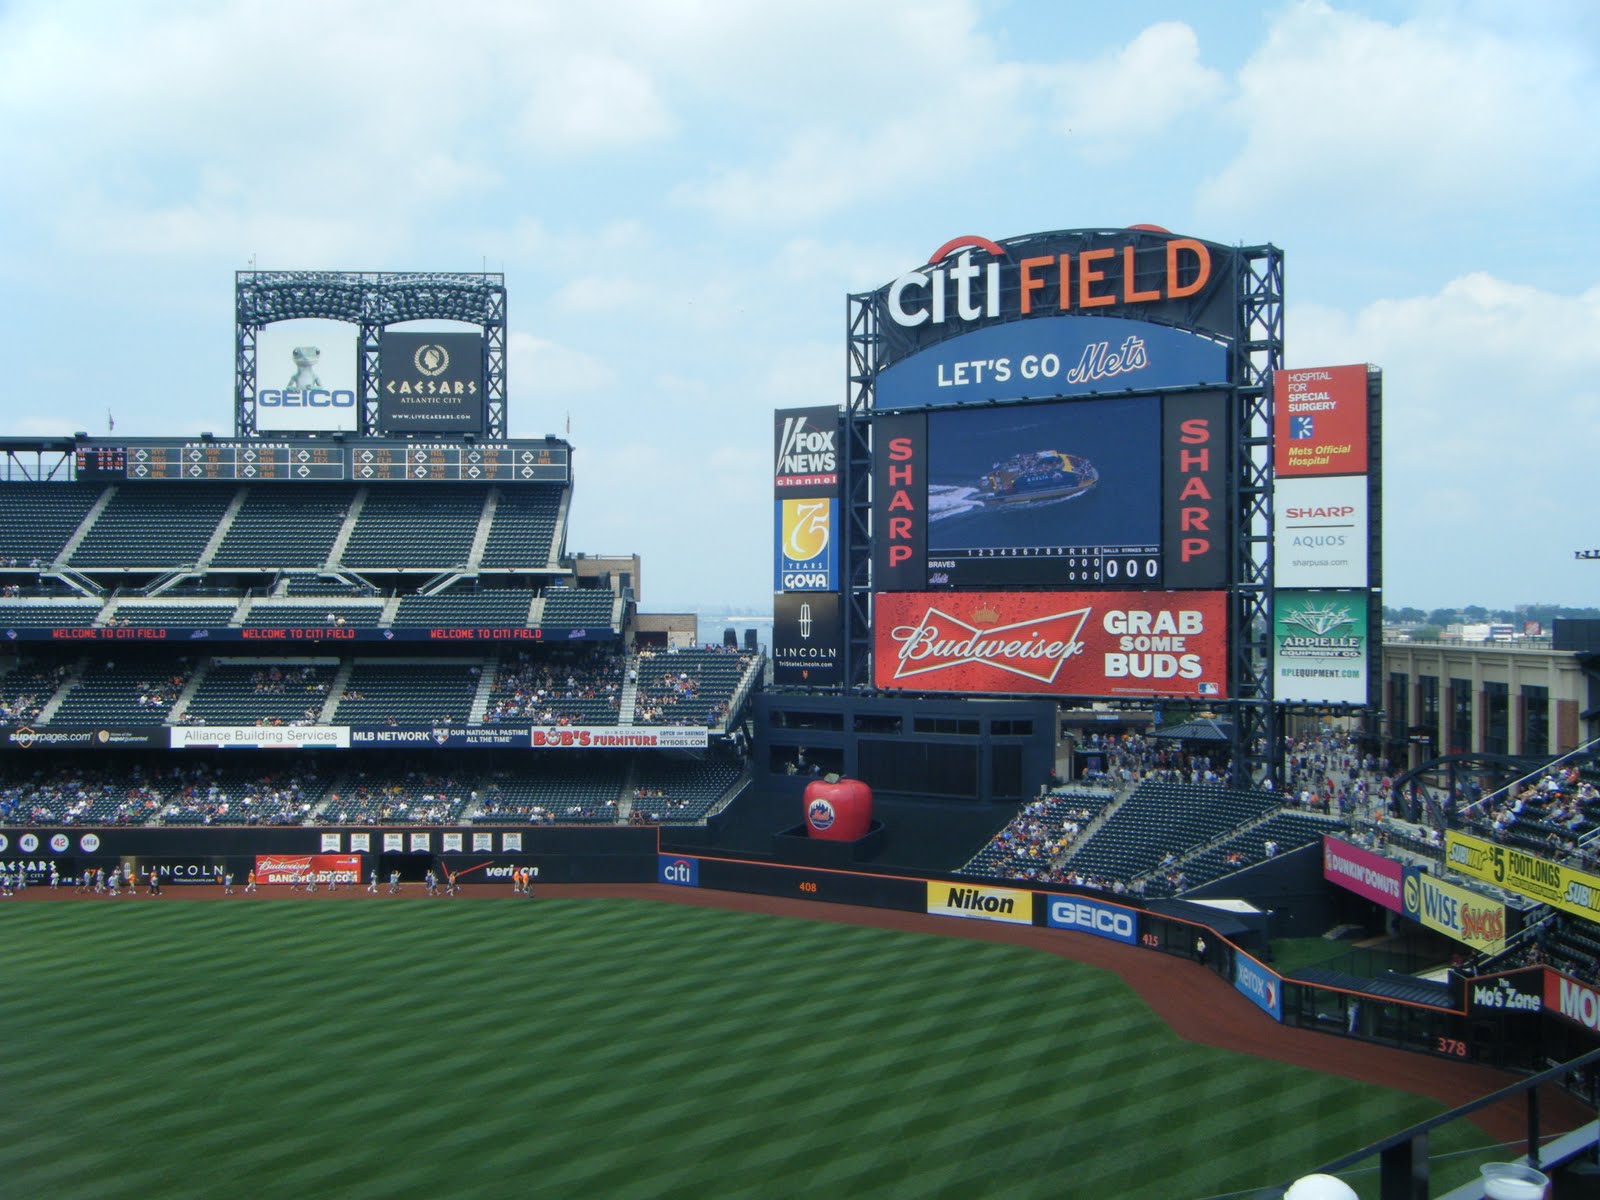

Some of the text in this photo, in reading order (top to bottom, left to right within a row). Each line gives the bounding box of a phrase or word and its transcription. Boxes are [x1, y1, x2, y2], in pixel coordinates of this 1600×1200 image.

[888, 239, 1212, 327] citi FIELD
[938, 336, 1148, 387] LET'S GO Mets
[1288, 371, 1332, 382] HOSPITAL
[386, 380, 477, 394] CAESARS
[1288, 383, 1307, 392] FOR
[259, 390, 354, 408] GEICO
[1288, 392, 1330, 402] SPECIAL
[1288, 401, 1336, 412] SURGERY
[796, 431, 835, 455] FOX
[1288, 444, 1351, 456] Mets Official
[785, 453, 836, 474] NEWS
[1288, 456, 1329, 467] Hospital
[777, 476, 837, 486] channel
[1179, 419, 1212, 562] SHARP
[887, 438, 914, 566] SHARP
[1285, 506, 1354, 518] SHARP
[783, 503, 830, 561] 75
[1292, 536, 1346, 548] AQUOS
[928, 561, 955, 569] BRAVES
[1069, 559, 1075, 567] 0
[1094, 558, 1099, 566] 0
[1106, 559, 1157, 578] 0 0 0
[785, 573, 827, 588] GOYA
[1069, 572, 1075, 580] 0
[1082, 572, 1087, 580] 0
[1103, 610, 1203, 635] GRAB
[52, 629, 167, 639] WELCOME TO CITI FIELD
[242, 629, 355, 639] WELCOME TO CITI FIELD
[430, 629, 541, 639] WELCOME TO CITI FIELD
[891, 626, 1084, 660] Budweiser
[1119, 636, 1187, 652] SOME
[1282, 637, 1359, 647] ARPIELLE
[776, 647, 837, 658] LINCOLN
[1104, 653, 1203, 679] BUDS
[10, 732, 92, 743] superpages.com
[184, 730, 337, 743] Alliance Building Services
[353, 732, 375, 741] MLB
[377, 732, 430, 741] NETWORK
[533, 728, 591, 746] BOB'S
[594, 735, 658, 746] FURNITURE
[24, 838, 34, 847] 41
[54, 838, 66, 847] 42
[256, 860, 311, 871] Budweiser
[1449, 841, 1489, 871] SUBWAY
[1489, 847, 1505, 882] $5
[1509, 851, 1561, 888] FOOTLONGS
[664, 863, 690, 882] citi
[1332, 854, 1400, 898] DUNKIN' DONUTS
[799, 881, 817, 892] 408
[947, 887, 1014, 914] Nikon
[1422, 881, 1504, 941] WISE SNACKS
[1052, 901, 1133, 936] GEICO
[1142, 933, 1159, 947] 415
[1238, 962, 1265, 998] xerox
[1498, 978, 1510, 988] The
[1474, 985, 1541, 1011] Mo's Zone
[1560, 978, 1600, 1029] MO
[1438, 1037, 1467, 1056] 378
